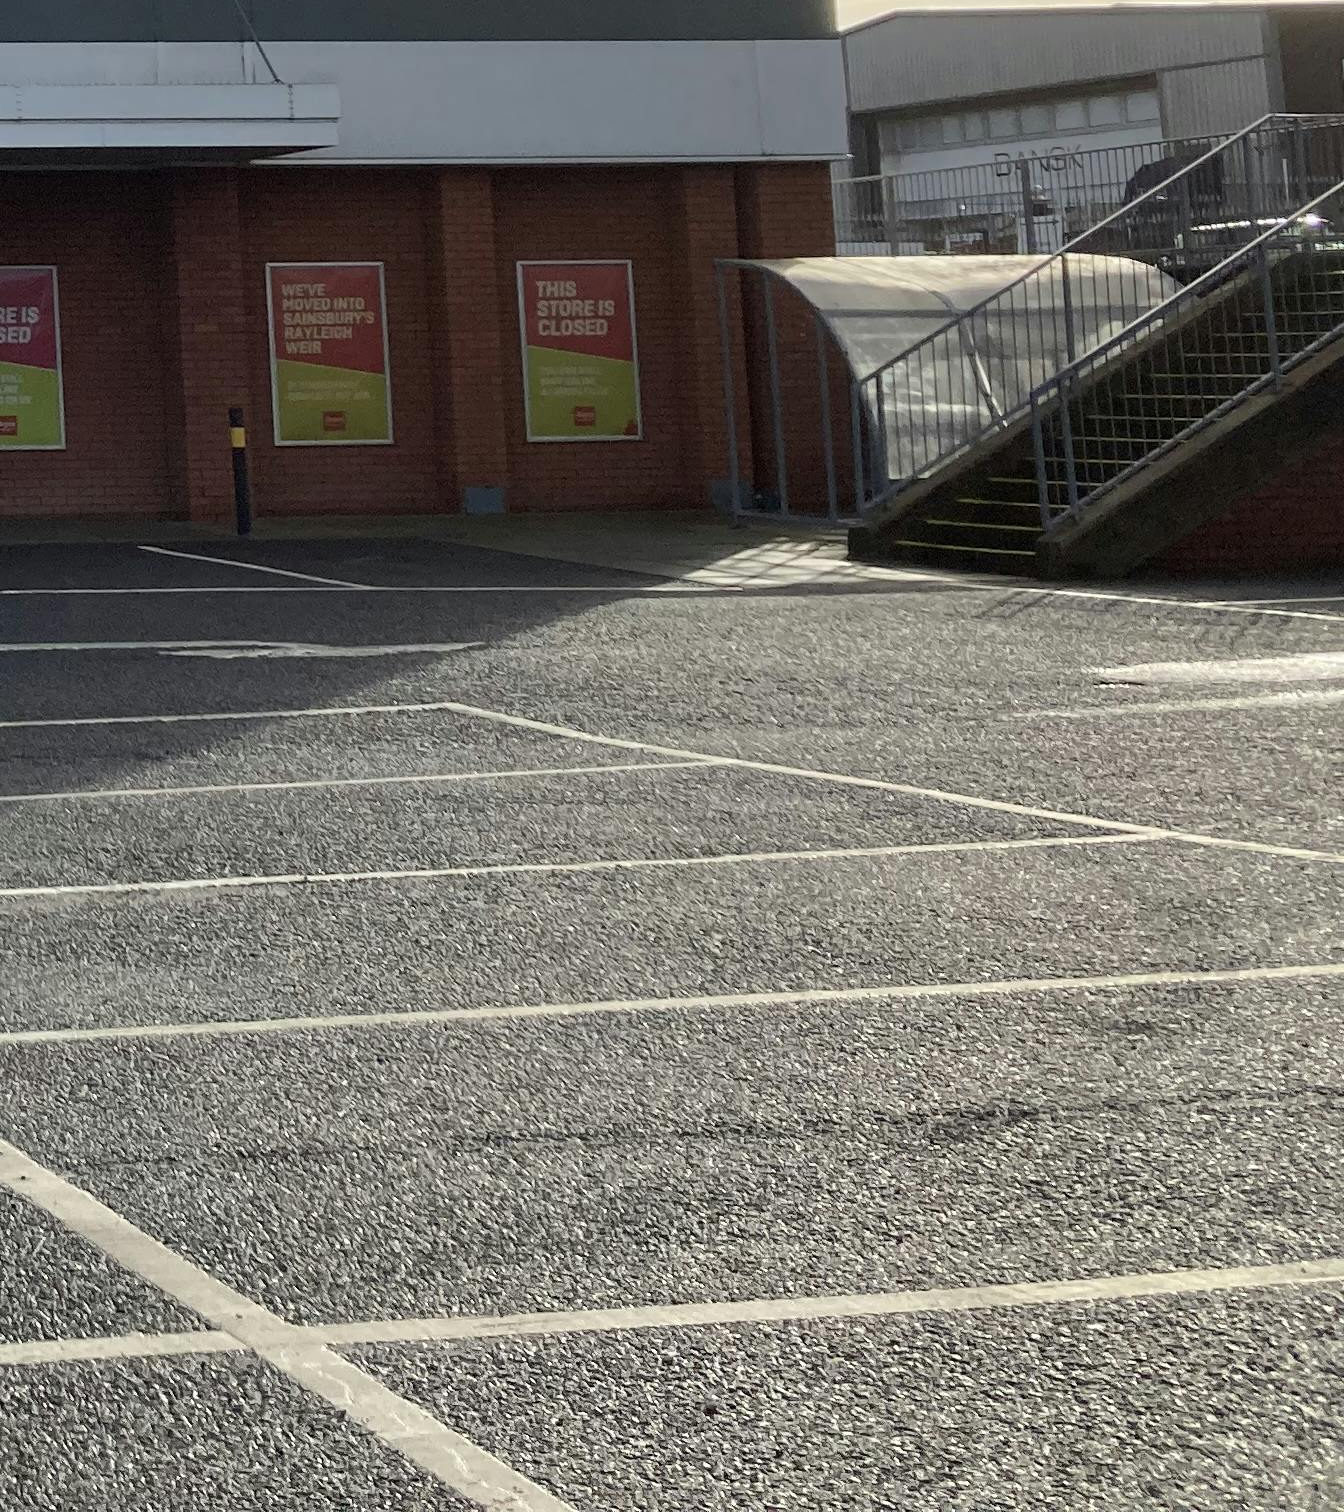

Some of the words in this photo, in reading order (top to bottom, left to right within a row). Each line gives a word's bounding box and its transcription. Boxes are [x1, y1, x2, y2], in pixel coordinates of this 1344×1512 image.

[282, 283, 326, 297] WE'VE
[536, 280, 577, 297] THIS
[282, 298, 331, 311] MOVED
[334, 297, 365, 310] INTO
[537, 299, 595, 317] STORE
[598, 299, 615, 316] IS
[21, 306, 40, 324] IS
[283, 311, 375, 325] SAINSBURY'S
[285, 326, 352, 339] RAYLEIGH
[538, 319, 608, 336] CLOSED
[286, 341, 321, 354] WEIR
